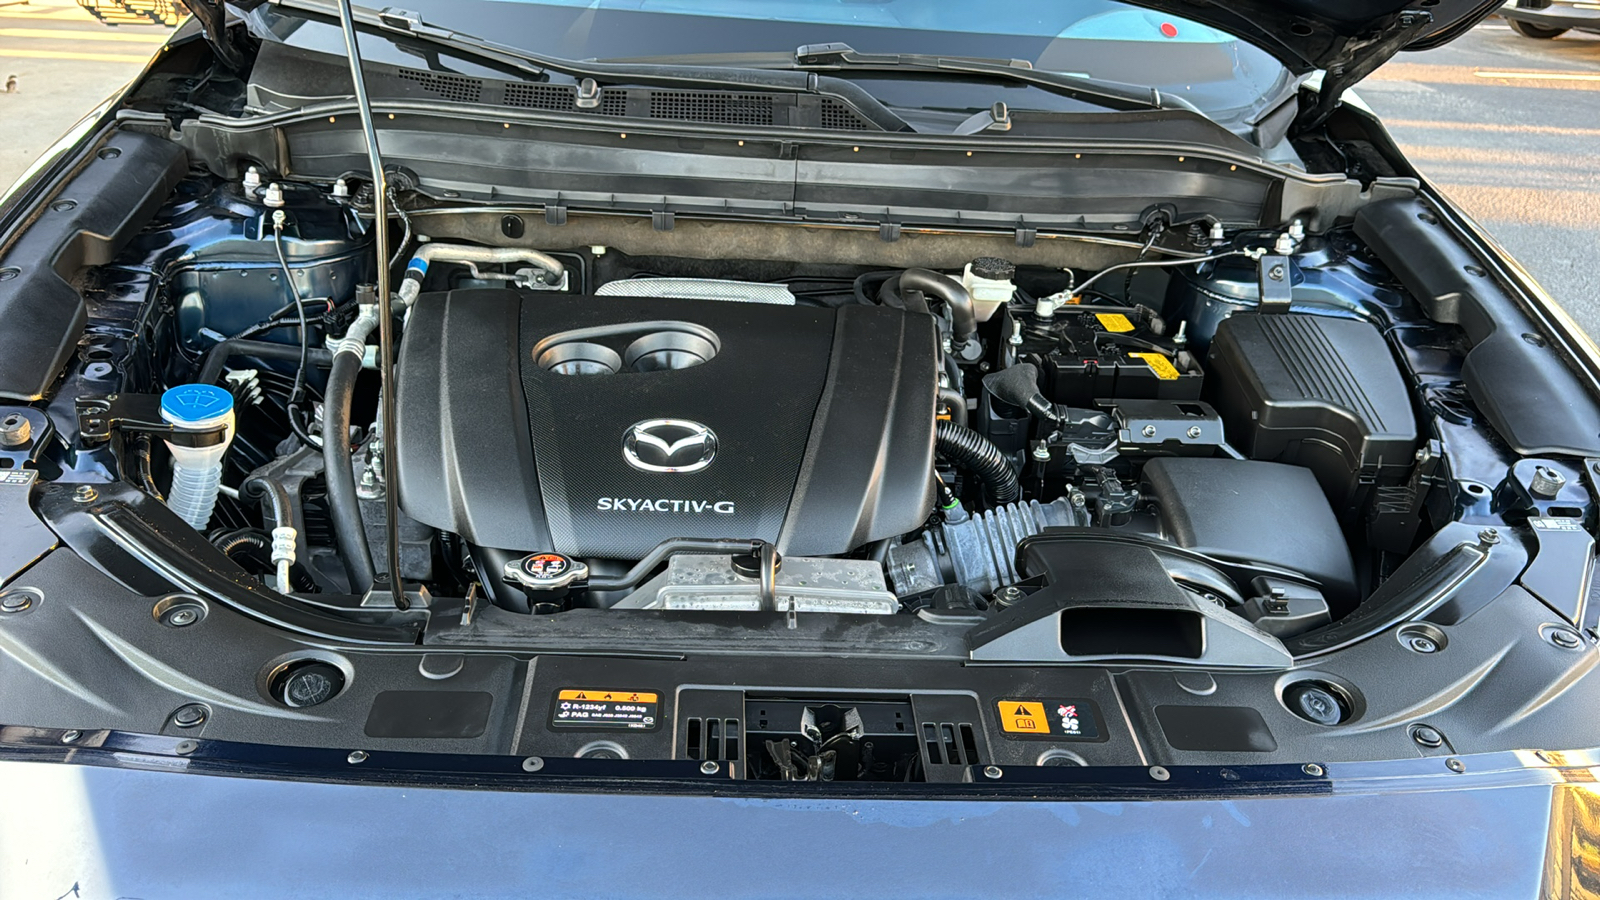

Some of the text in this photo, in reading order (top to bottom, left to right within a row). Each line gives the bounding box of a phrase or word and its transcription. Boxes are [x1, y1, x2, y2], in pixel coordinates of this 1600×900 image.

[597, 497, 735, 514] SKYACTIV-G
[572, 703, 607, 711] R-1234yf
[636, 705, 647, 713] kg
